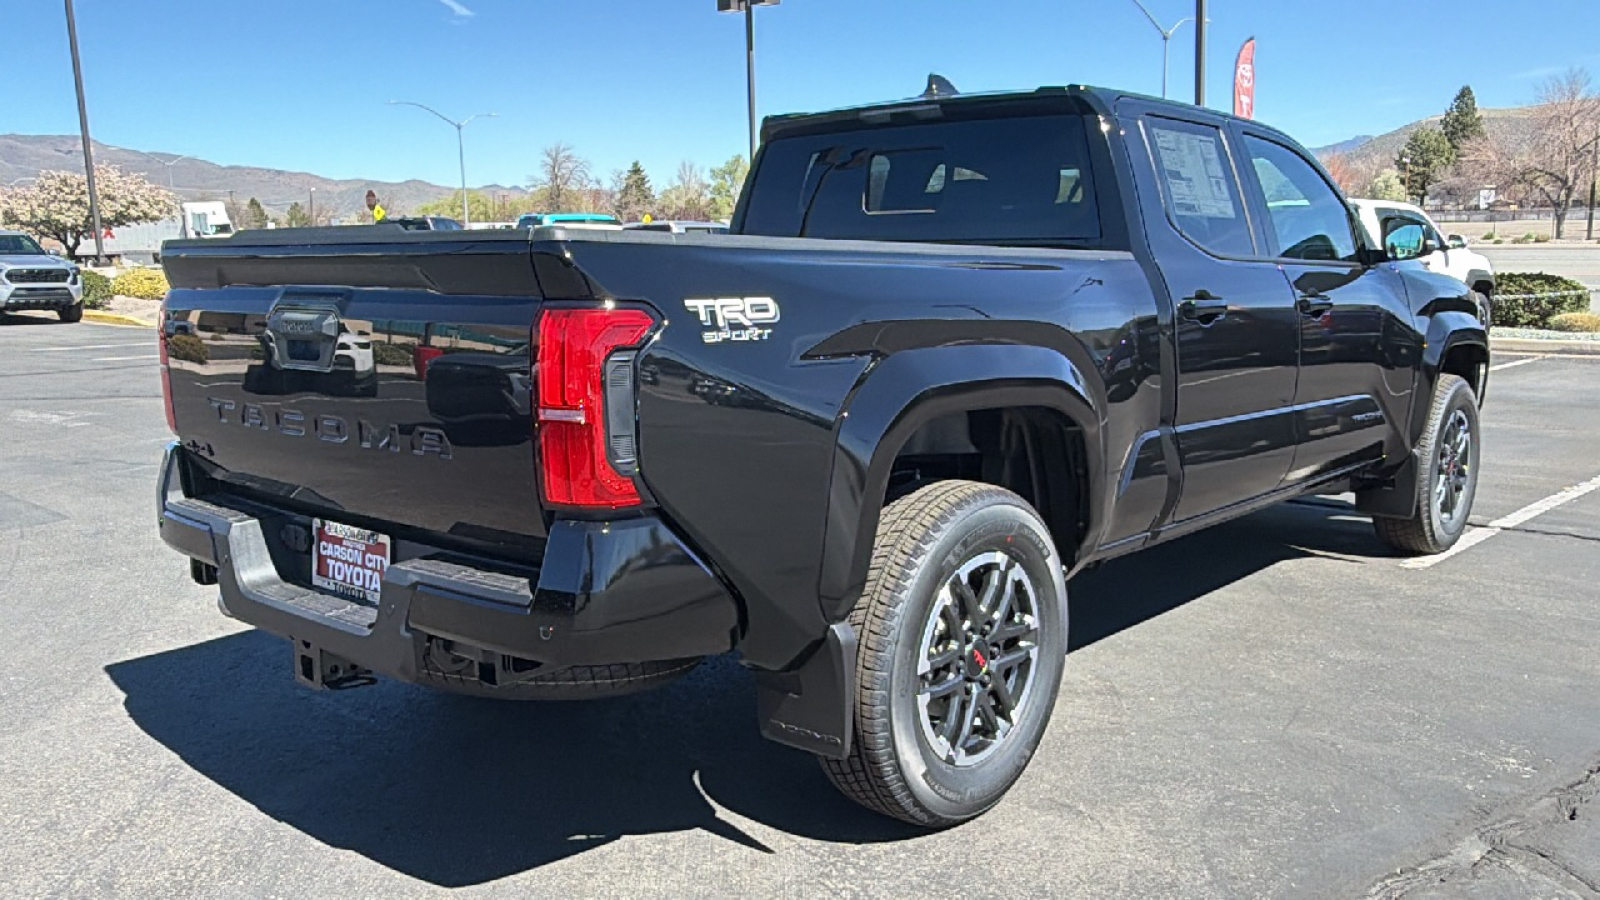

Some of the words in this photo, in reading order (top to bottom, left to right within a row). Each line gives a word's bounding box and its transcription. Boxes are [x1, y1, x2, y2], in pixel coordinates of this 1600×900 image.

[684, 297, 780, 330] TRD
[702, 329, 772, 343] SPORT
[207, 397, 453, 460] TACOMA
[320, 541, 362, 565] CARSON
[365, 553, 387, 571] CITY
[326, 559, 380, 592] TOYOTA
[333, 582, 366, 600] TOYOTA
